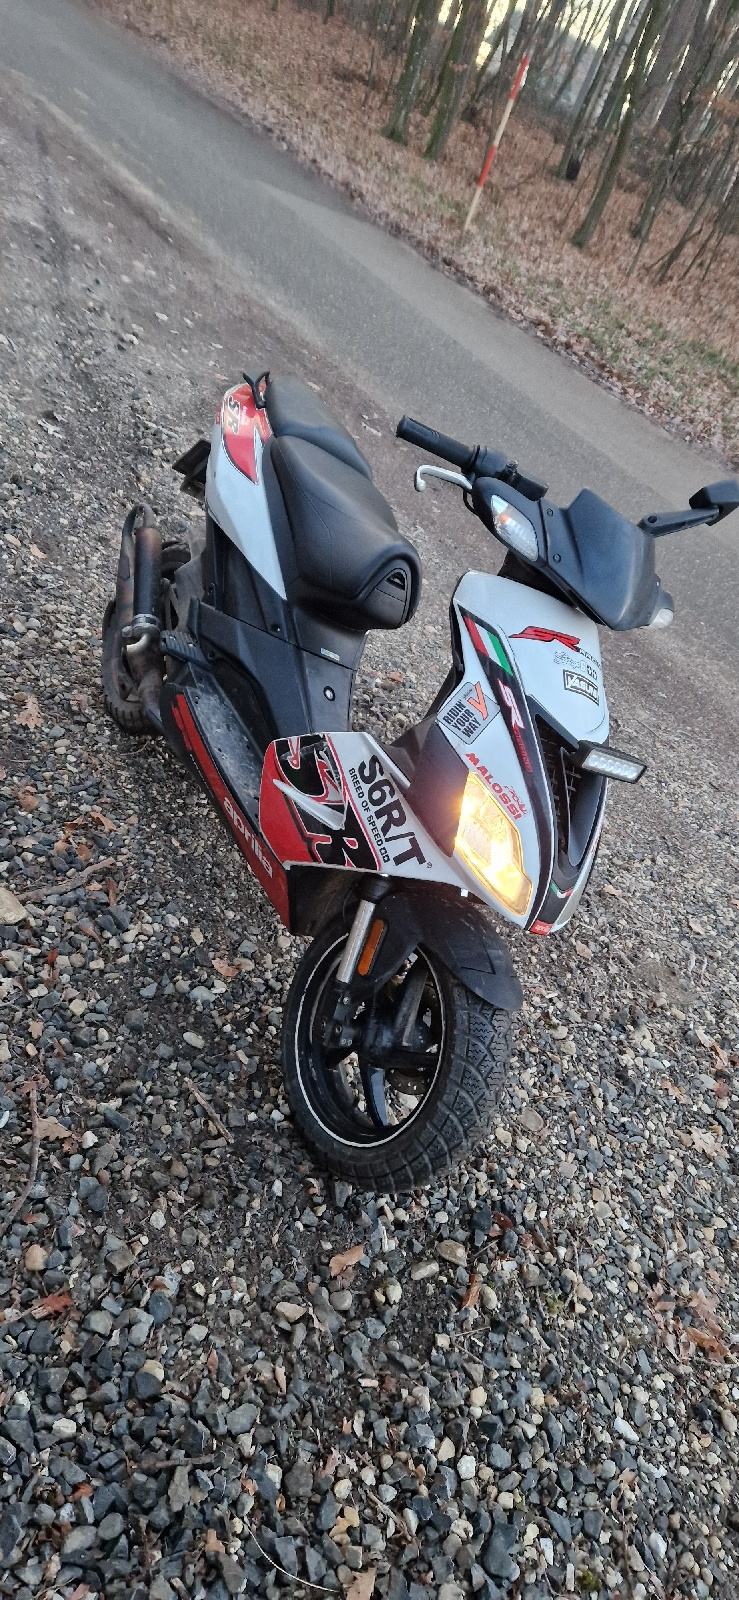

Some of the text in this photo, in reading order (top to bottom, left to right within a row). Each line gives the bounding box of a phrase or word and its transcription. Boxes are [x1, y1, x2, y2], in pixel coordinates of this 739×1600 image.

[450, 710, 475, 732] YOUR
[461, 719, 482, 739] WAY
[348, 767, 383, 847] BREED OF SPEED
[464, 752, 524, 821] MALOSSI
[222, 797, 274, 879] aprilia
